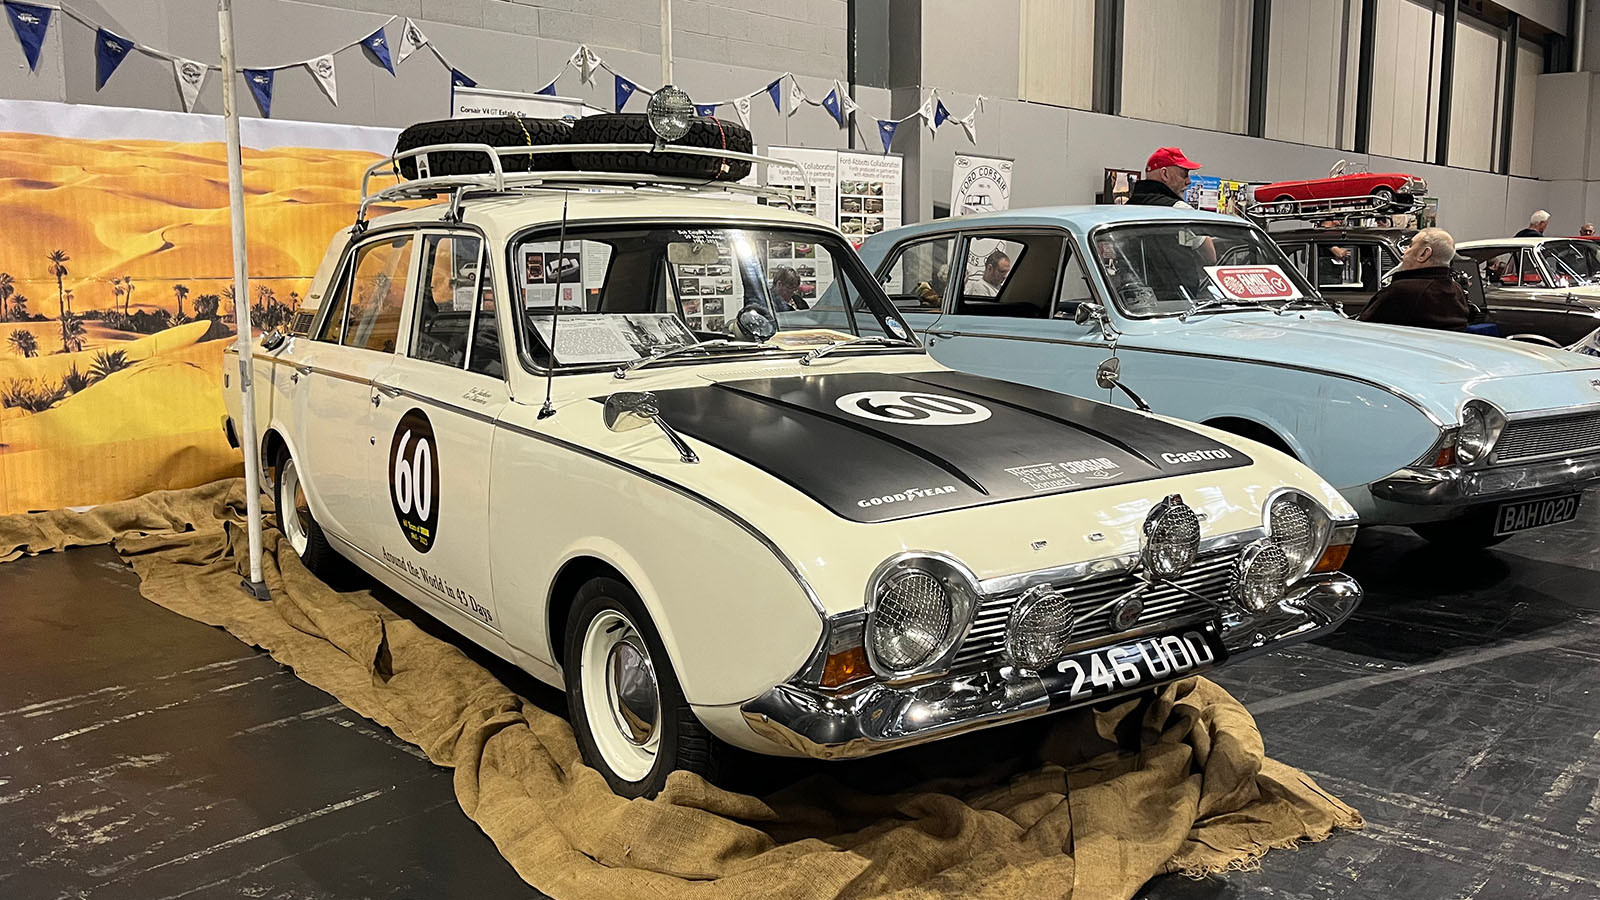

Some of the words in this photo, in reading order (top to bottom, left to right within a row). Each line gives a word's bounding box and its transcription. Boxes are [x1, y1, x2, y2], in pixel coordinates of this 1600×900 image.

[460, 105, 480, 114] Corsair
[804, 162, 836, 171] Collaboration
[840, 157, 851, 165] Ford
[870, 160, 899, 169] Collaboration
[960, 172, 977, 196] FORD
[978, 167, 1007, 192] CORSAIR
[1236, 273, 1271, 286] FAMILY
[856, 395, 977, 420] 60
[1161, 448, 1232, 464] Castrol
[1041, 463, 1060, 476] got
[1058, 457, 1120, 474] CORSAIR
[394, 429, 432, 522] 60
[857, 485, 958, 508] GOODYEAR
[381, 545, 408, 572] Around
[407, 560, 420, 579] the
[419, 566, 446, 594] World
[444, 580, 457, 600] in
[456, 587, 469, 607] 43
[468, 594, 494, 623] Days
[1057, 647, 1141, 701] 246
